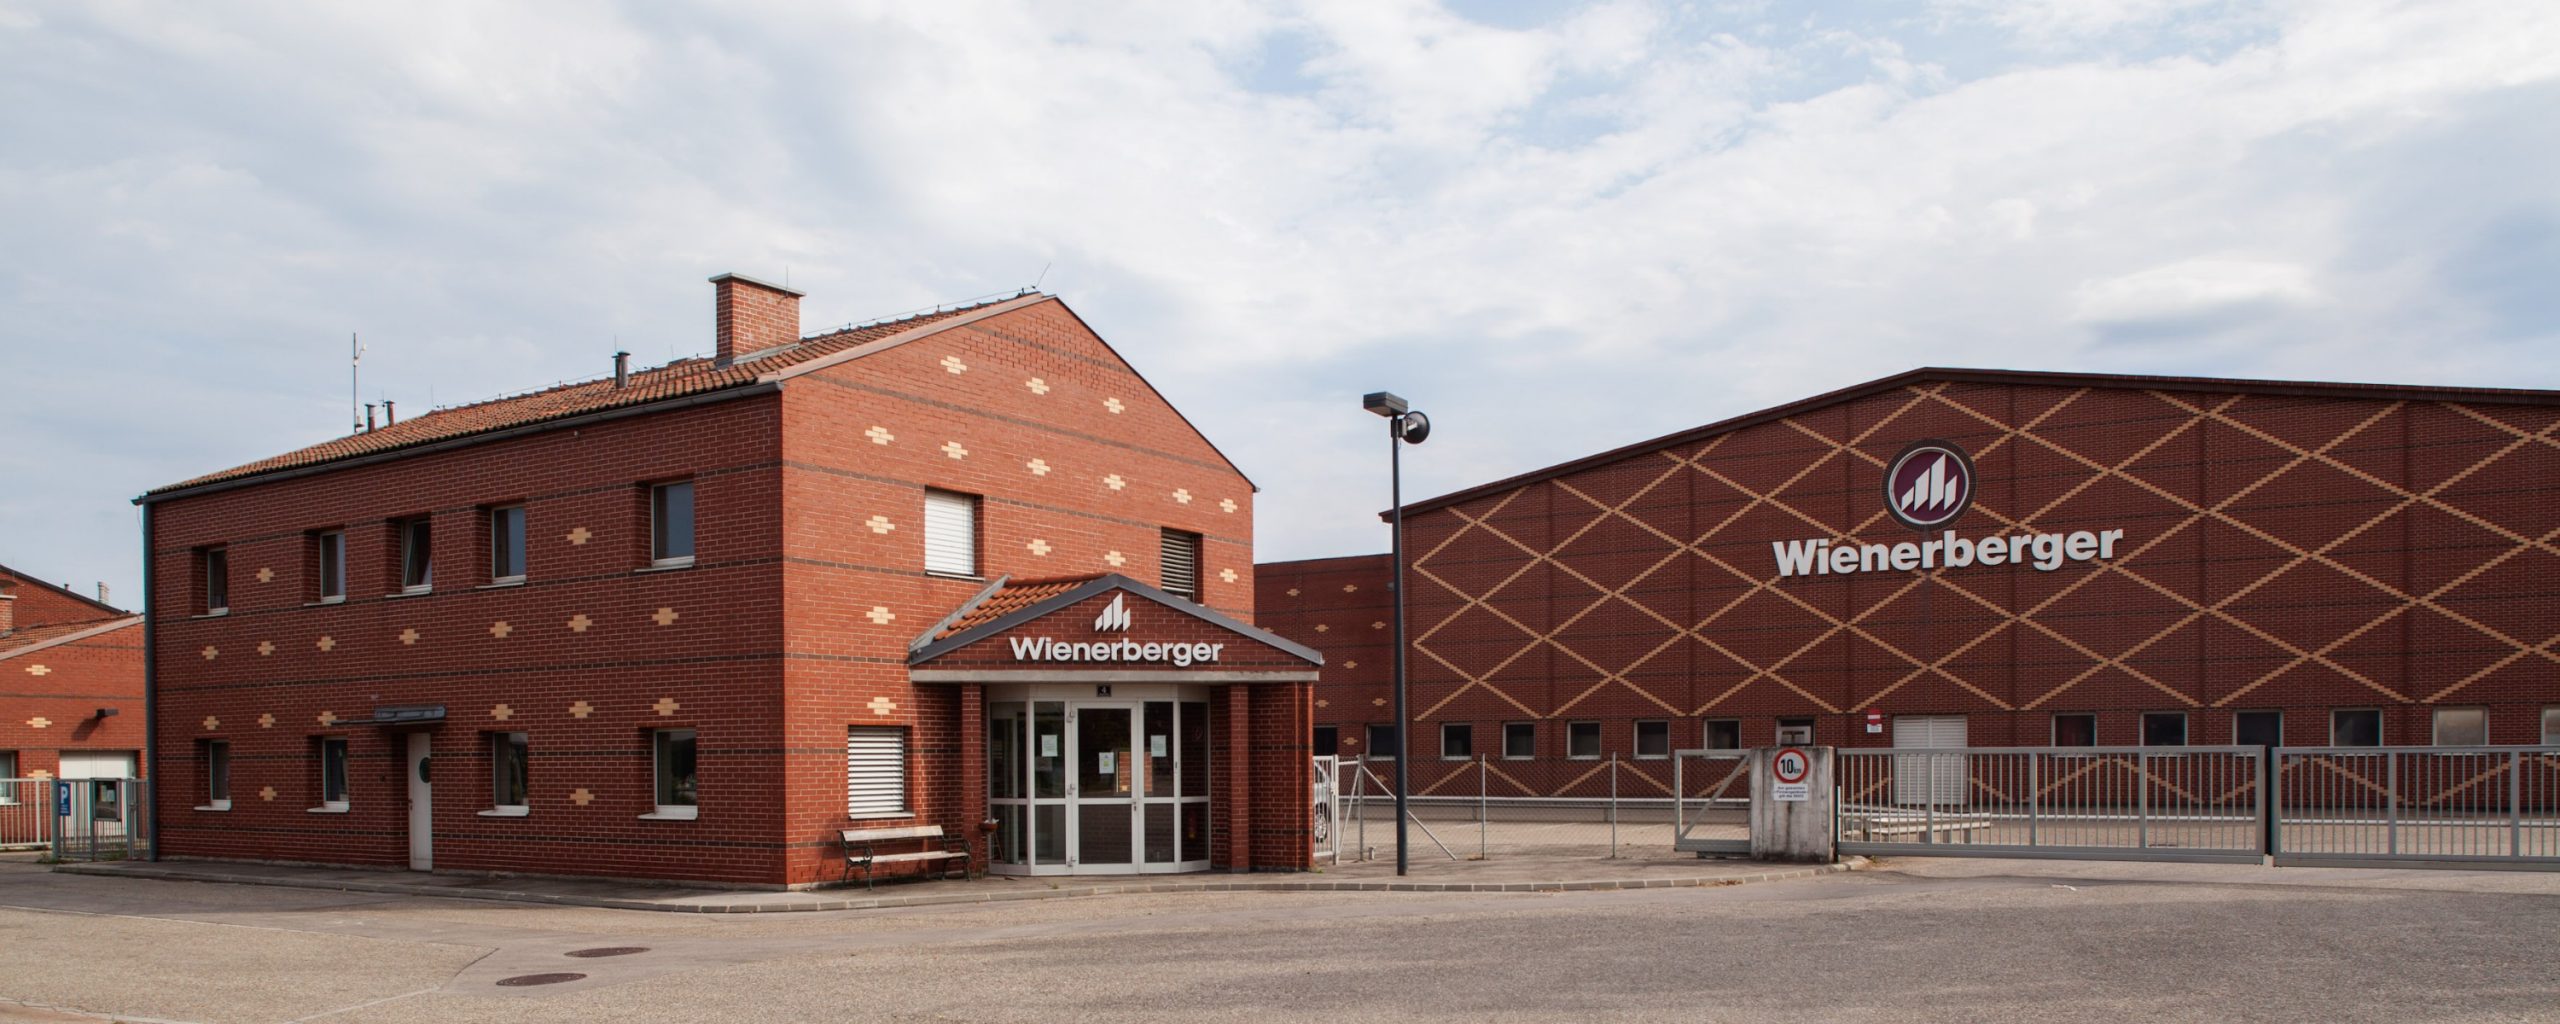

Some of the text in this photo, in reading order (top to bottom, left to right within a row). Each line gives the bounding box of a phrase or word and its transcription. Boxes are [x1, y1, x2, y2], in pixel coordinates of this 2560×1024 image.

[1772, 528, 2124, 577] Wienerberger
[1009, 636, 1224, 667] Wienerberger
[1780, 758, 1794, 774] 10
[60, 786, 69, 803] P
